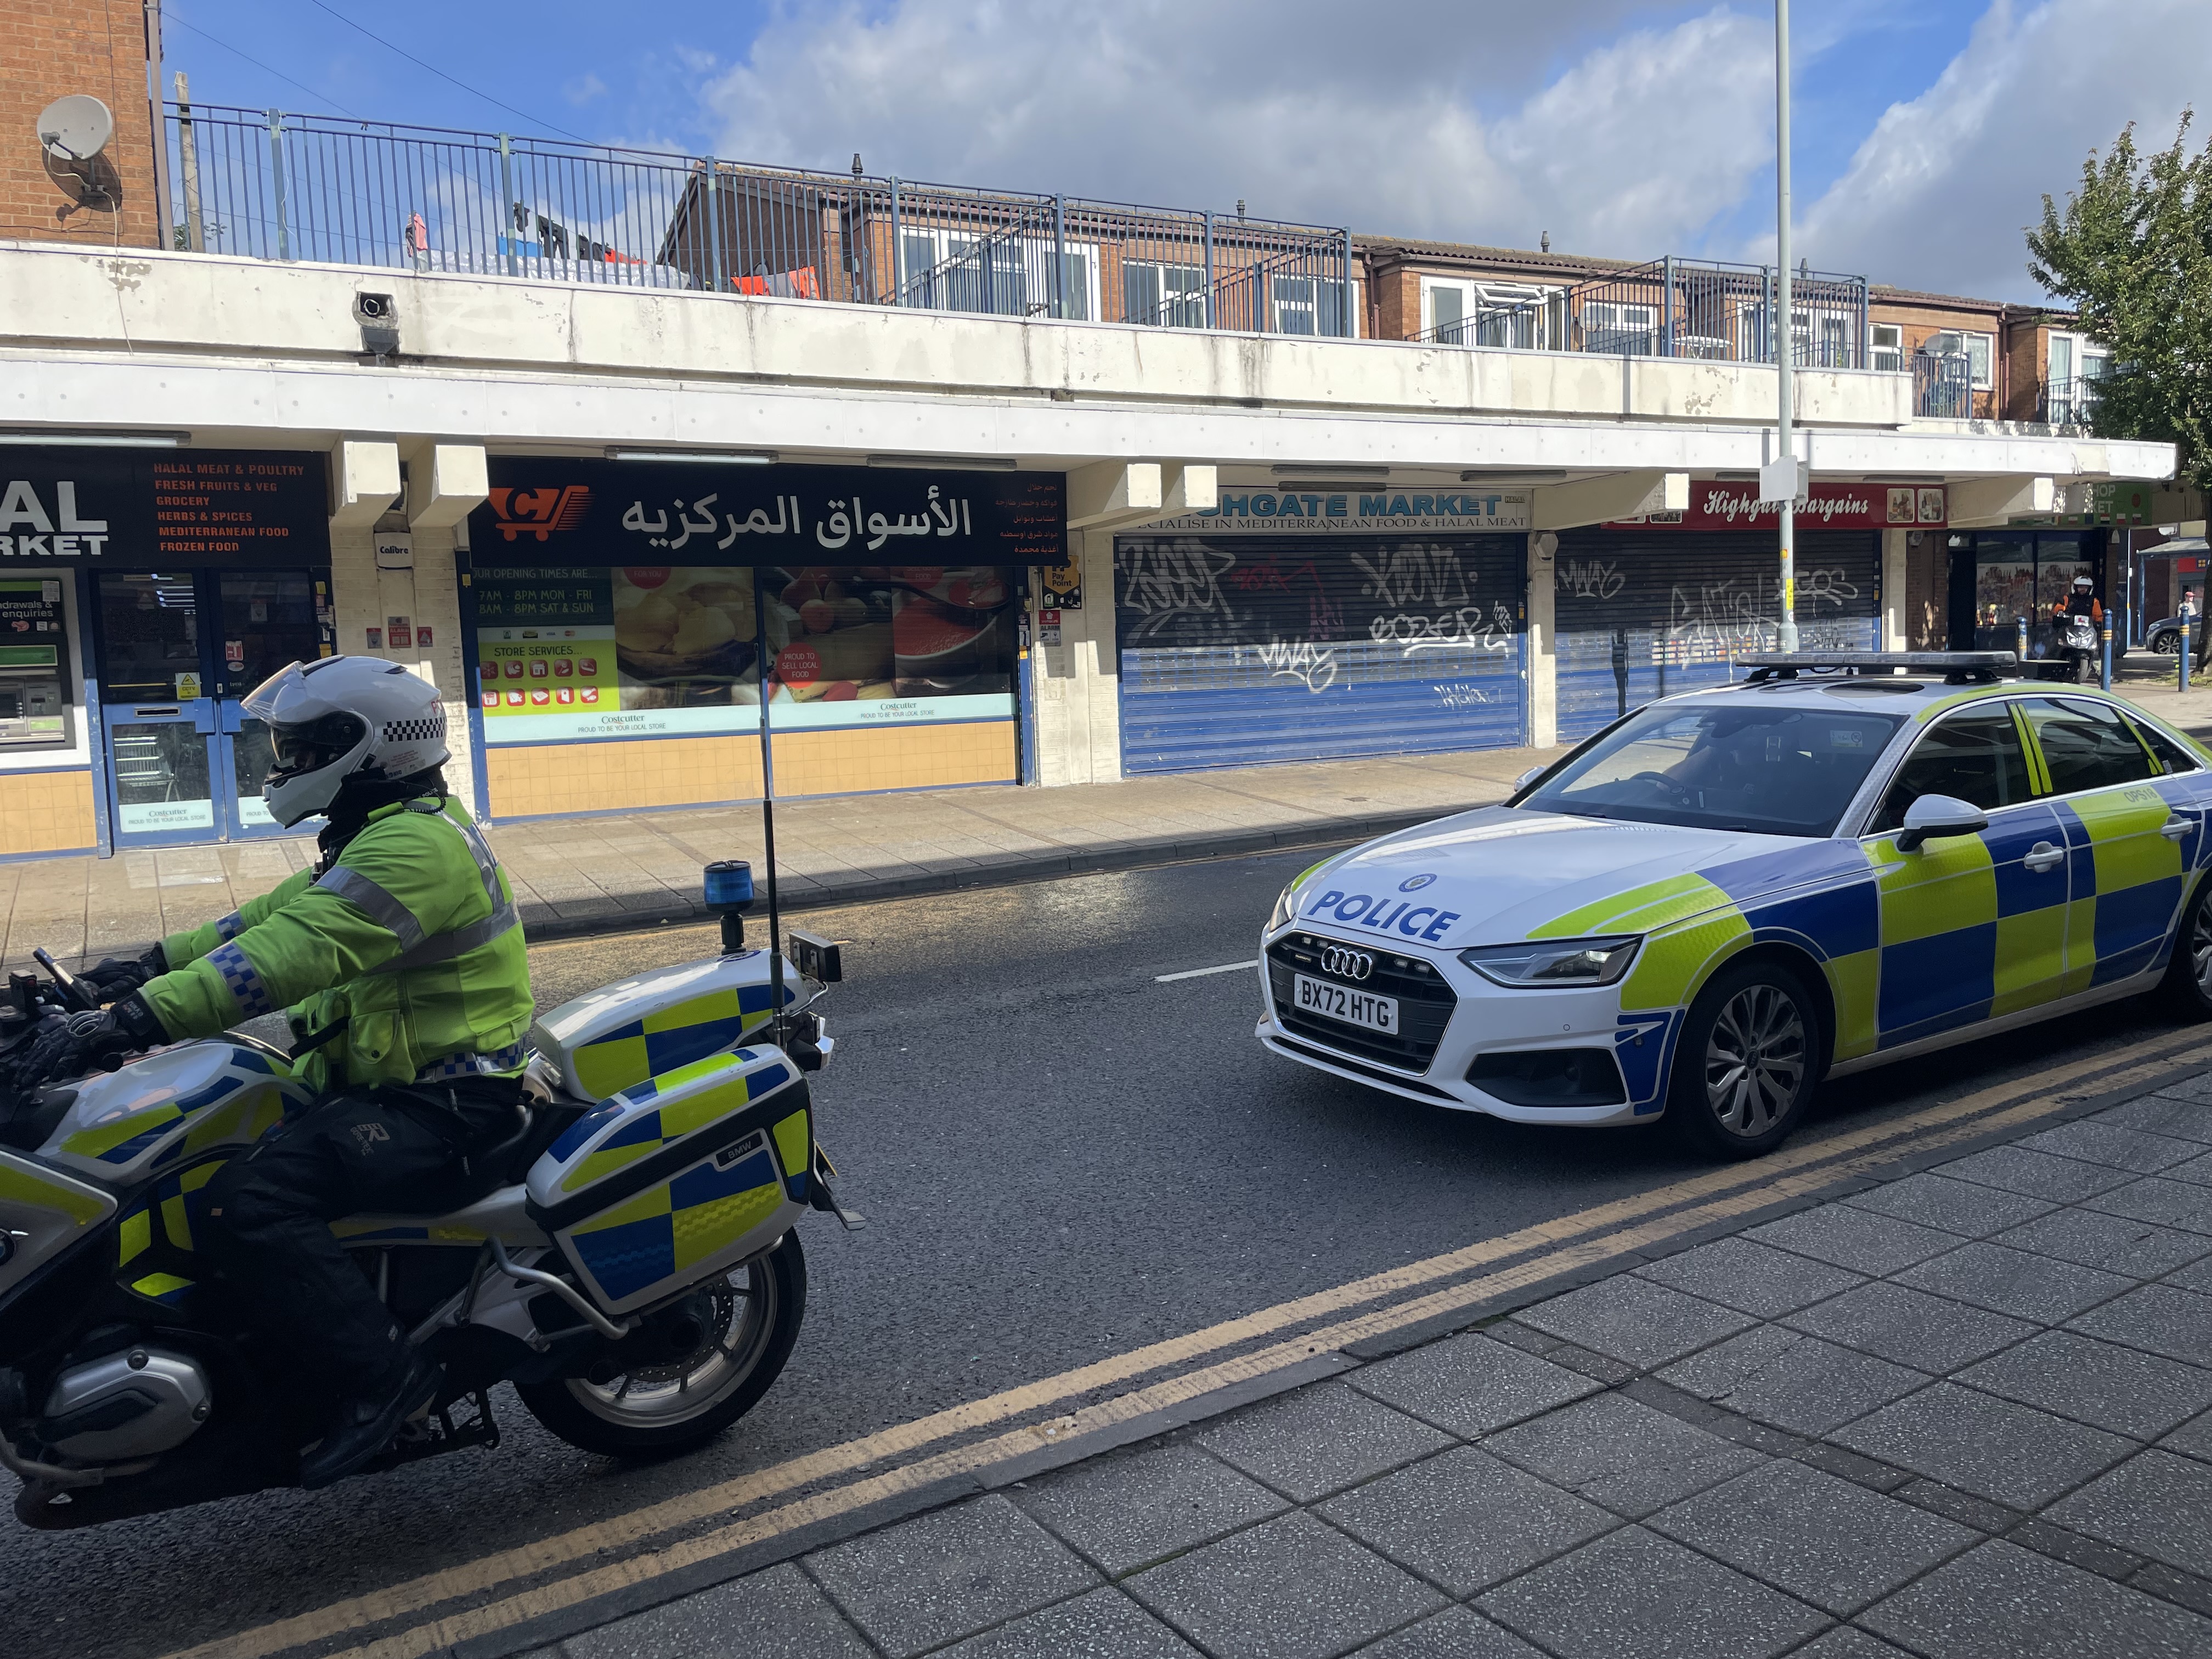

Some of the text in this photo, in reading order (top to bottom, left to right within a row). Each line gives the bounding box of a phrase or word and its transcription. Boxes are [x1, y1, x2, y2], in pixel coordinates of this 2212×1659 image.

[154, 463, 304, 476] HALAL MEAT & POULTRY
[155, 480, 277, 492] FRESH FRUITS & VEG
[156, 496, 210, 506] GROCERY
[1359, 495, 1502, 516] MARKET
[157, 511, 252, 521] HERBS & SPICES
[622, 485, 970, 550] الأسواق المركزيه
[1216, 519, 1232, 528] IN
[1237, 518, 1371, 529] MEDITERRANEAN
[1376, 518, 1417, 527] FOOD
[1420, 518, 1430, 527] &
[1435, 518, 1482, 527] HALAL
[1487, 517, 1526, 526] MEAT
[159, 527, 289, 537] MEDITERRANEAN FOOD
[160, 542, 240, 551] FROZEN FOOD
[380, 546, 408, 554] Calibre
[494, 569, 536, 578] OPENING
[539, 568, 568, 578] TIMES
[1052, 572, 1065, 580] Pay
[479, 590, 502, 601] 7AM
[515, 590, 537, 600] 8PM
[541, 590, 565, 600] MON
[577, 589, 592, 600] FRI
[0, 600, 42, 609] drawals
[479, 603, 502, 614] 8AM
[515, 603, 537, 613] 8PM
[540, 603, 558, 613] SAT
[562, 603, 568, 613] &
[572, 602, 594, 613] SUN
[2, 610, 53, 619] enquiries
[494, 647, 525, 657] STORE
[881, 702, 917, 710] Costcutter
[601, 715, 645, 724] Costcutter
[2124, 788, 2158, 803] OPS18
[149, 809, 187, 817] Costcutter
[1307, 890, 1462, 942] POLICE
[1302, 980, 1389, 1026] BX72 HTG
[728, 1141, 751, 1159] BMW
